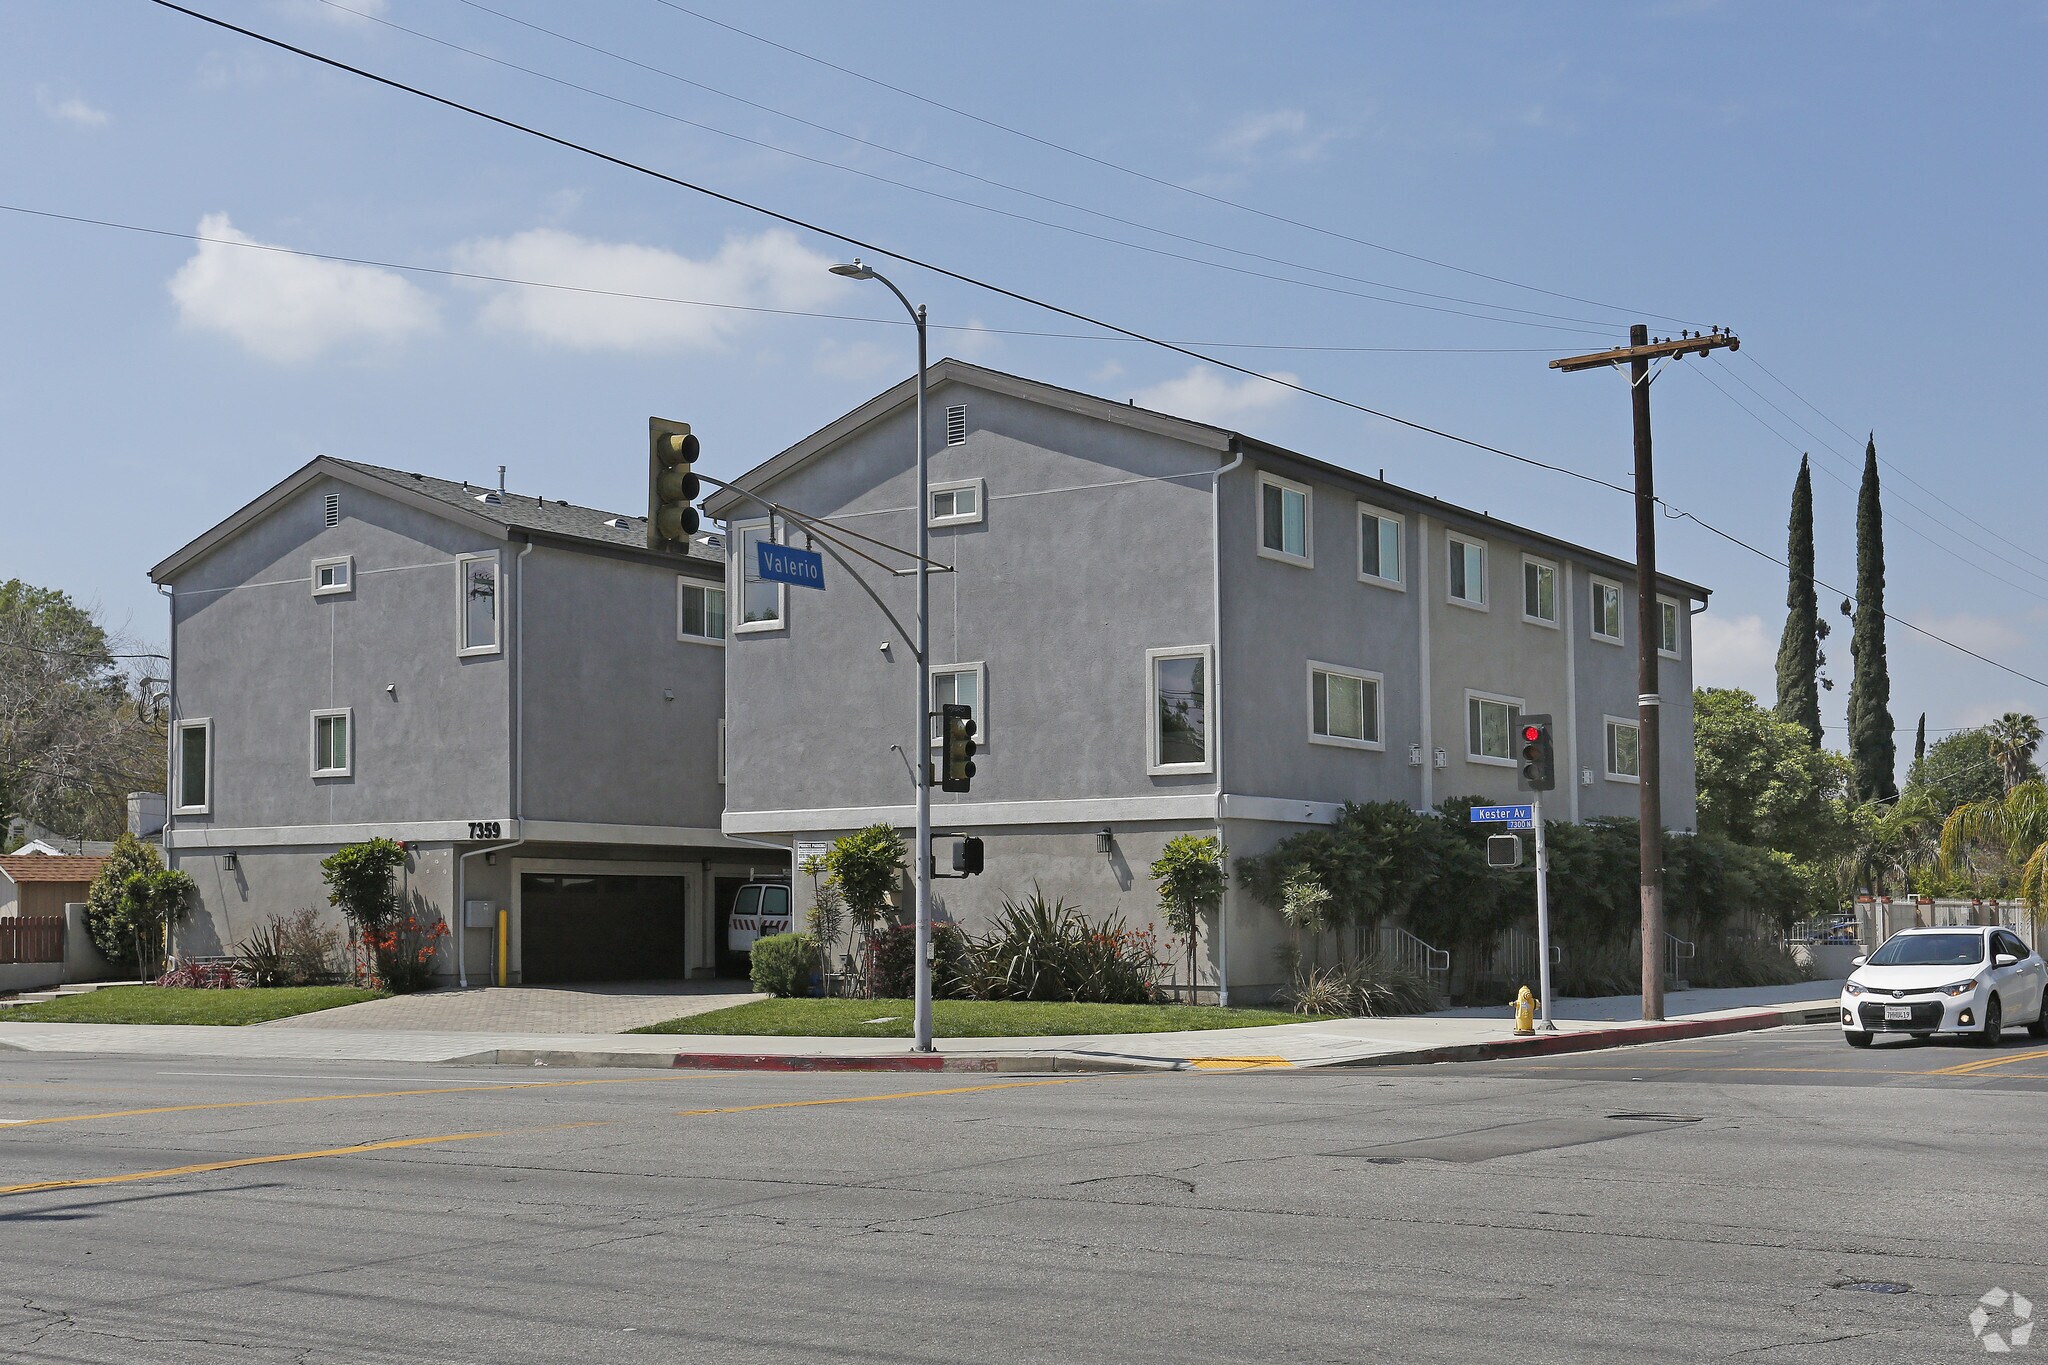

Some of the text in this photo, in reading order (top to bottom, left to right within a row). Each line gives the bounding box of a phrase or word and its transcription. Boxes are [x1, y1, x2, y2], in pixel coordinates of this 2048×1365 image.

[764, 551, 817, 579] Valerio
[1479, 808, 1525, 819] Kester Av
[468, 821, 501, 839] 7359
[1510, 820, 1531, 829] 7300 N
